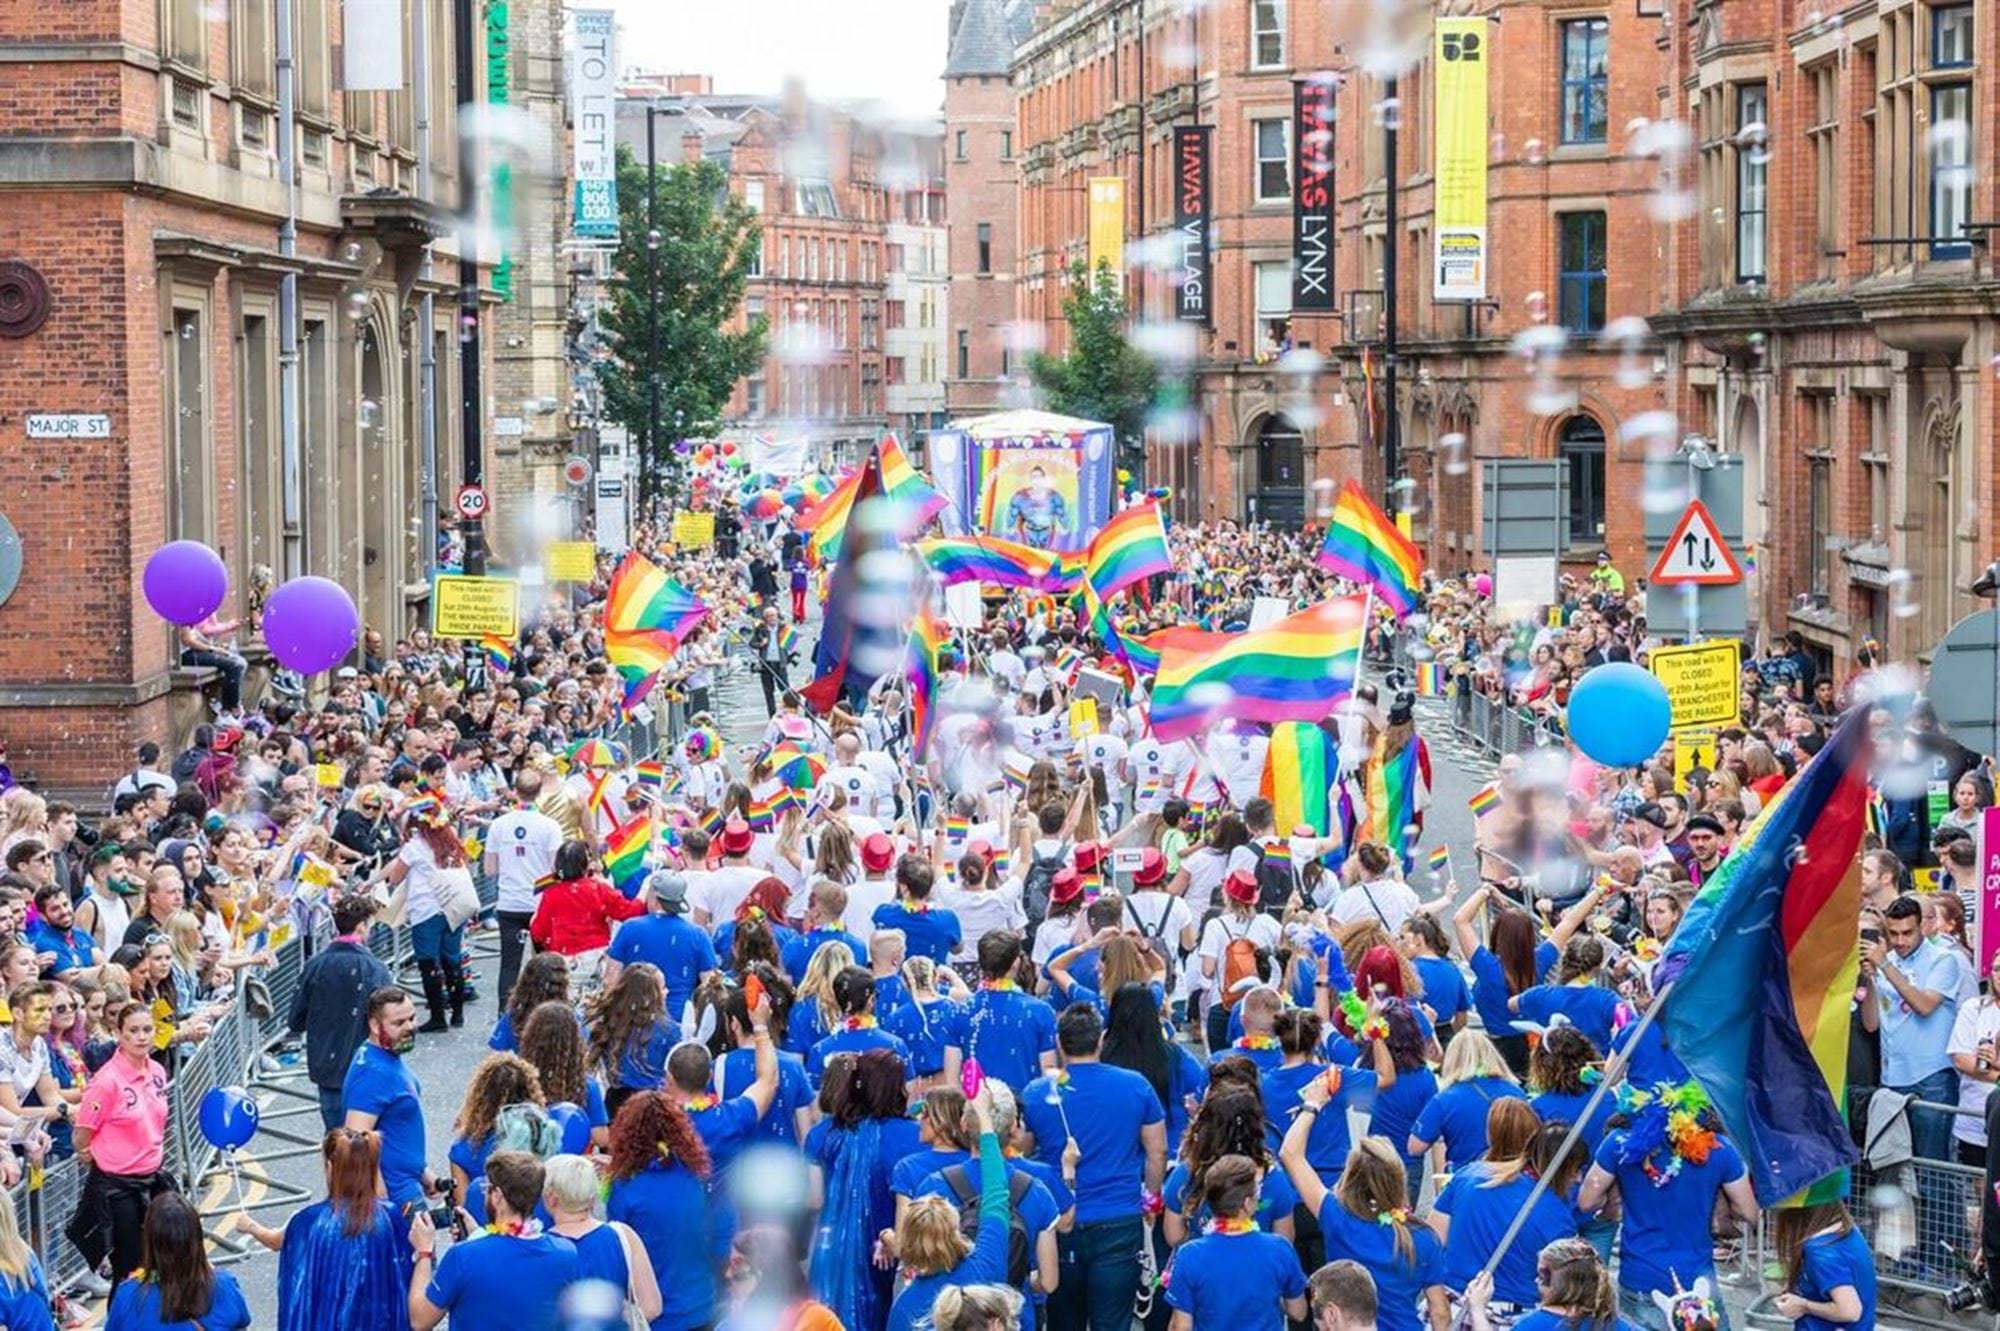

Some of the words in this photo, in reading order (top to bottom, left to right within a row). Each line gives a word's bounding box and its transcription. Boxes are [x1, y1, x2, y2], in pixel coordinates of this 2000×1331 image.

[582, 38, 606, 80] TO
[582, 95, 605, 152] LET
[1183, 133, 1201, 214] HAVAS
[1301, 215, 1327, 294] LYNX
[1183, 219, 1202, 310] VILLAGE
[29, 419, 79, 433] MAJOR
[462, 494, 484, 508] 20
[462, 594, 494, 603] CLOSED
[459, 613, 510, 623] MANCHESTER
[1666, 659, 1682, 669] This
[1684, 657, 1701, 667] road
[1703, 655, 1715, 664] will
[1716, 654, 1726, 664] be
[1680, 667, 1714, 681] CLOSED
[1694, 681, 1719, 693] August
[1720, 680, 1731, 688] for
[1679, 691, 1732, 706] MANCHESTER
[1695, 704, 1725, 718] PARADE
